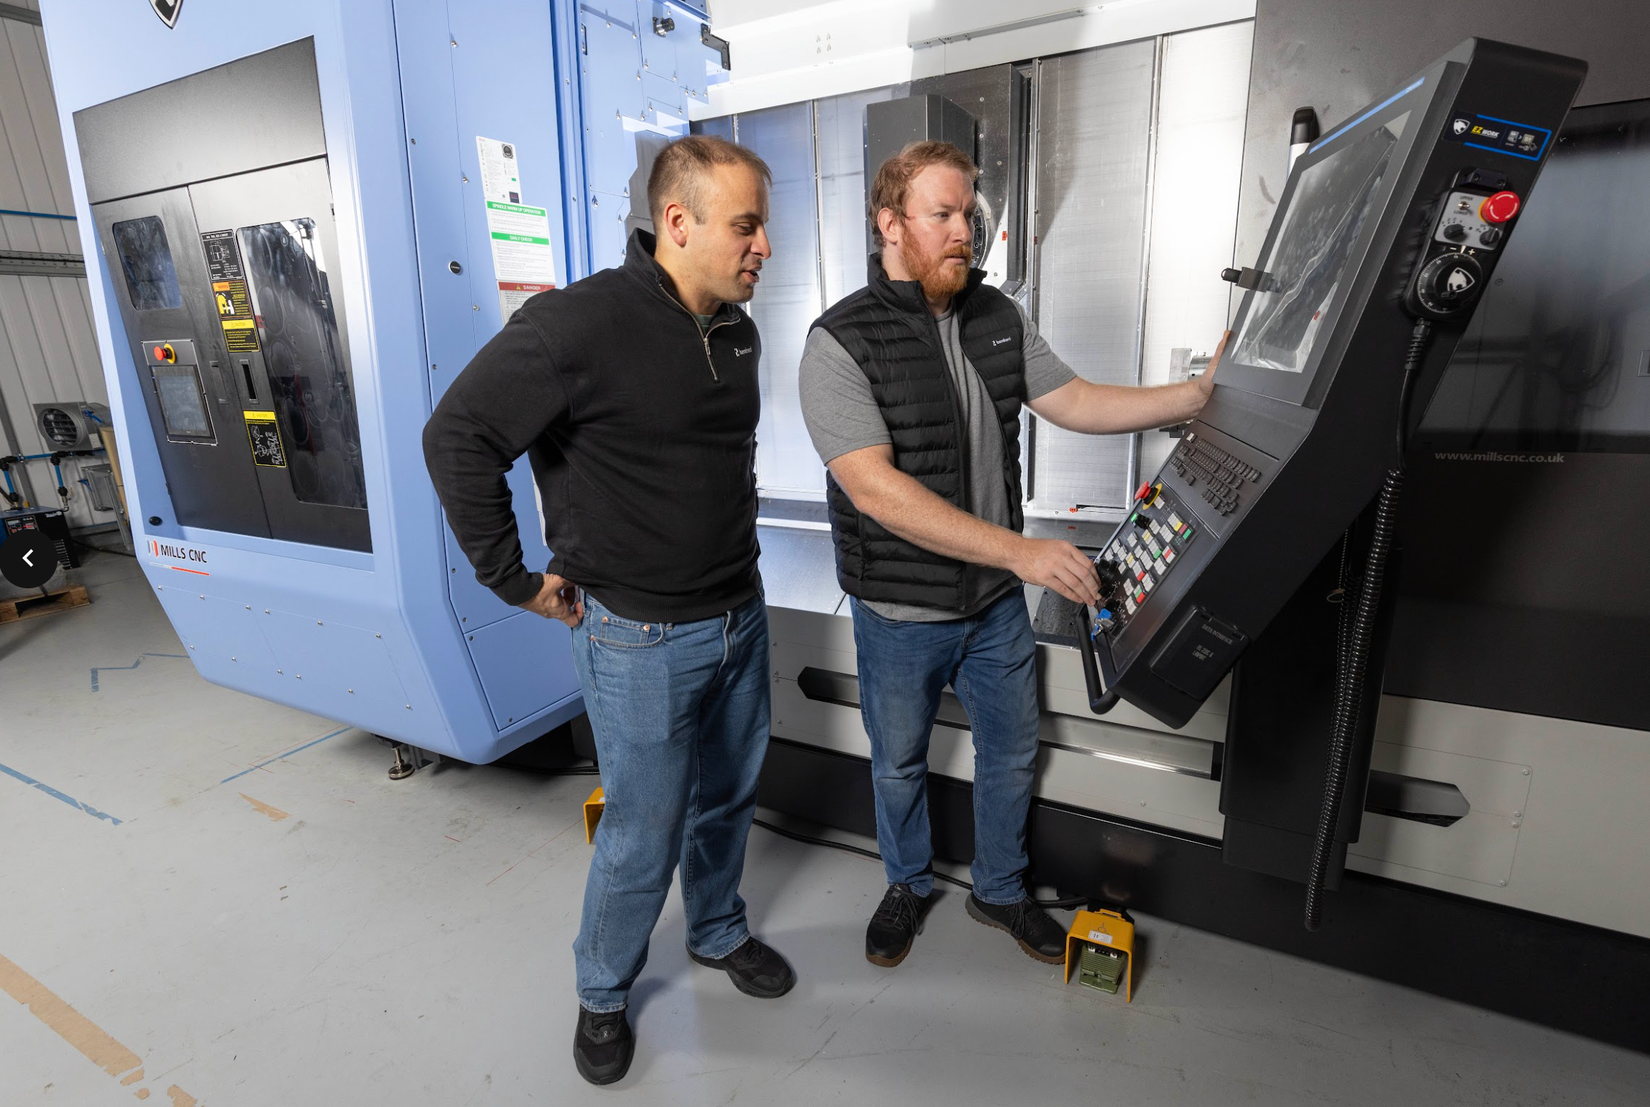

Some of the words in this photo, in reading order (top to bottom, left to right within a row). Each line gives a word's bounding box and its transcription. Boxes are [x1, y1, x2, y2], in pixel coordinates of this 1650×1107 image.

[1470, 125, 1484, 135] EZ
[1481, 129, 1500, 138] WORK
[1435, 451, 1565, 463] www.millscnc.co.uk
[161, 545, 186, 559] MILLS
[188, 549, 208, 563] CNC
[1202, 624, 1212, 634] DATA
